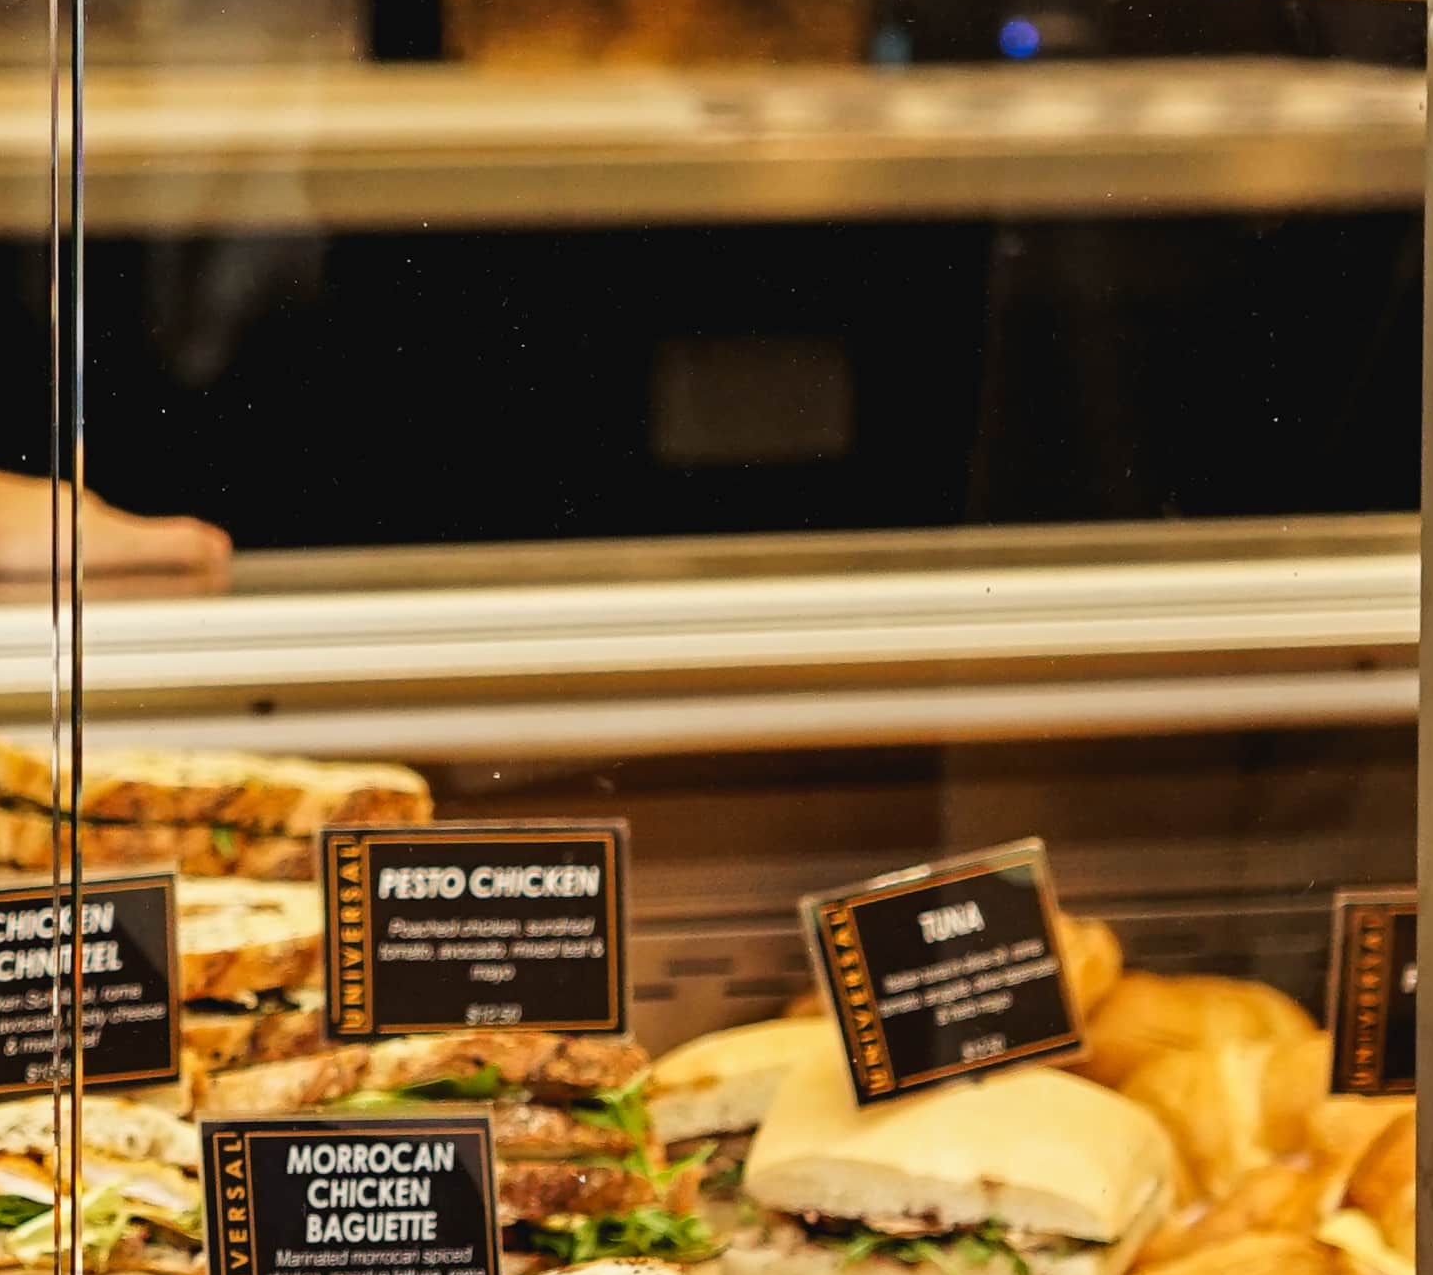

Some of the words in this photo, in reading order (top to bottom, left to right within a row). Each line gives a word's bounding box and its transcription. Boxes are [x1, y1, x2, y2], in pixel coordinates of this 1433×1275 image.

[378, 866, 467, 900] PESTO
[468, 865, 601, 898] CHICKEN
[339, 845, 365, 1028] UNIVERSAL
[287, 1141, 455, 1175] MORROCAN
[307, 1176, 431, 1209] CHICKEN
[305, 1211, 438, 1244] BAGUETTE
[275, 1249, 349, 1267] Marinated
[421, 1245, 473, 1266] spiced
